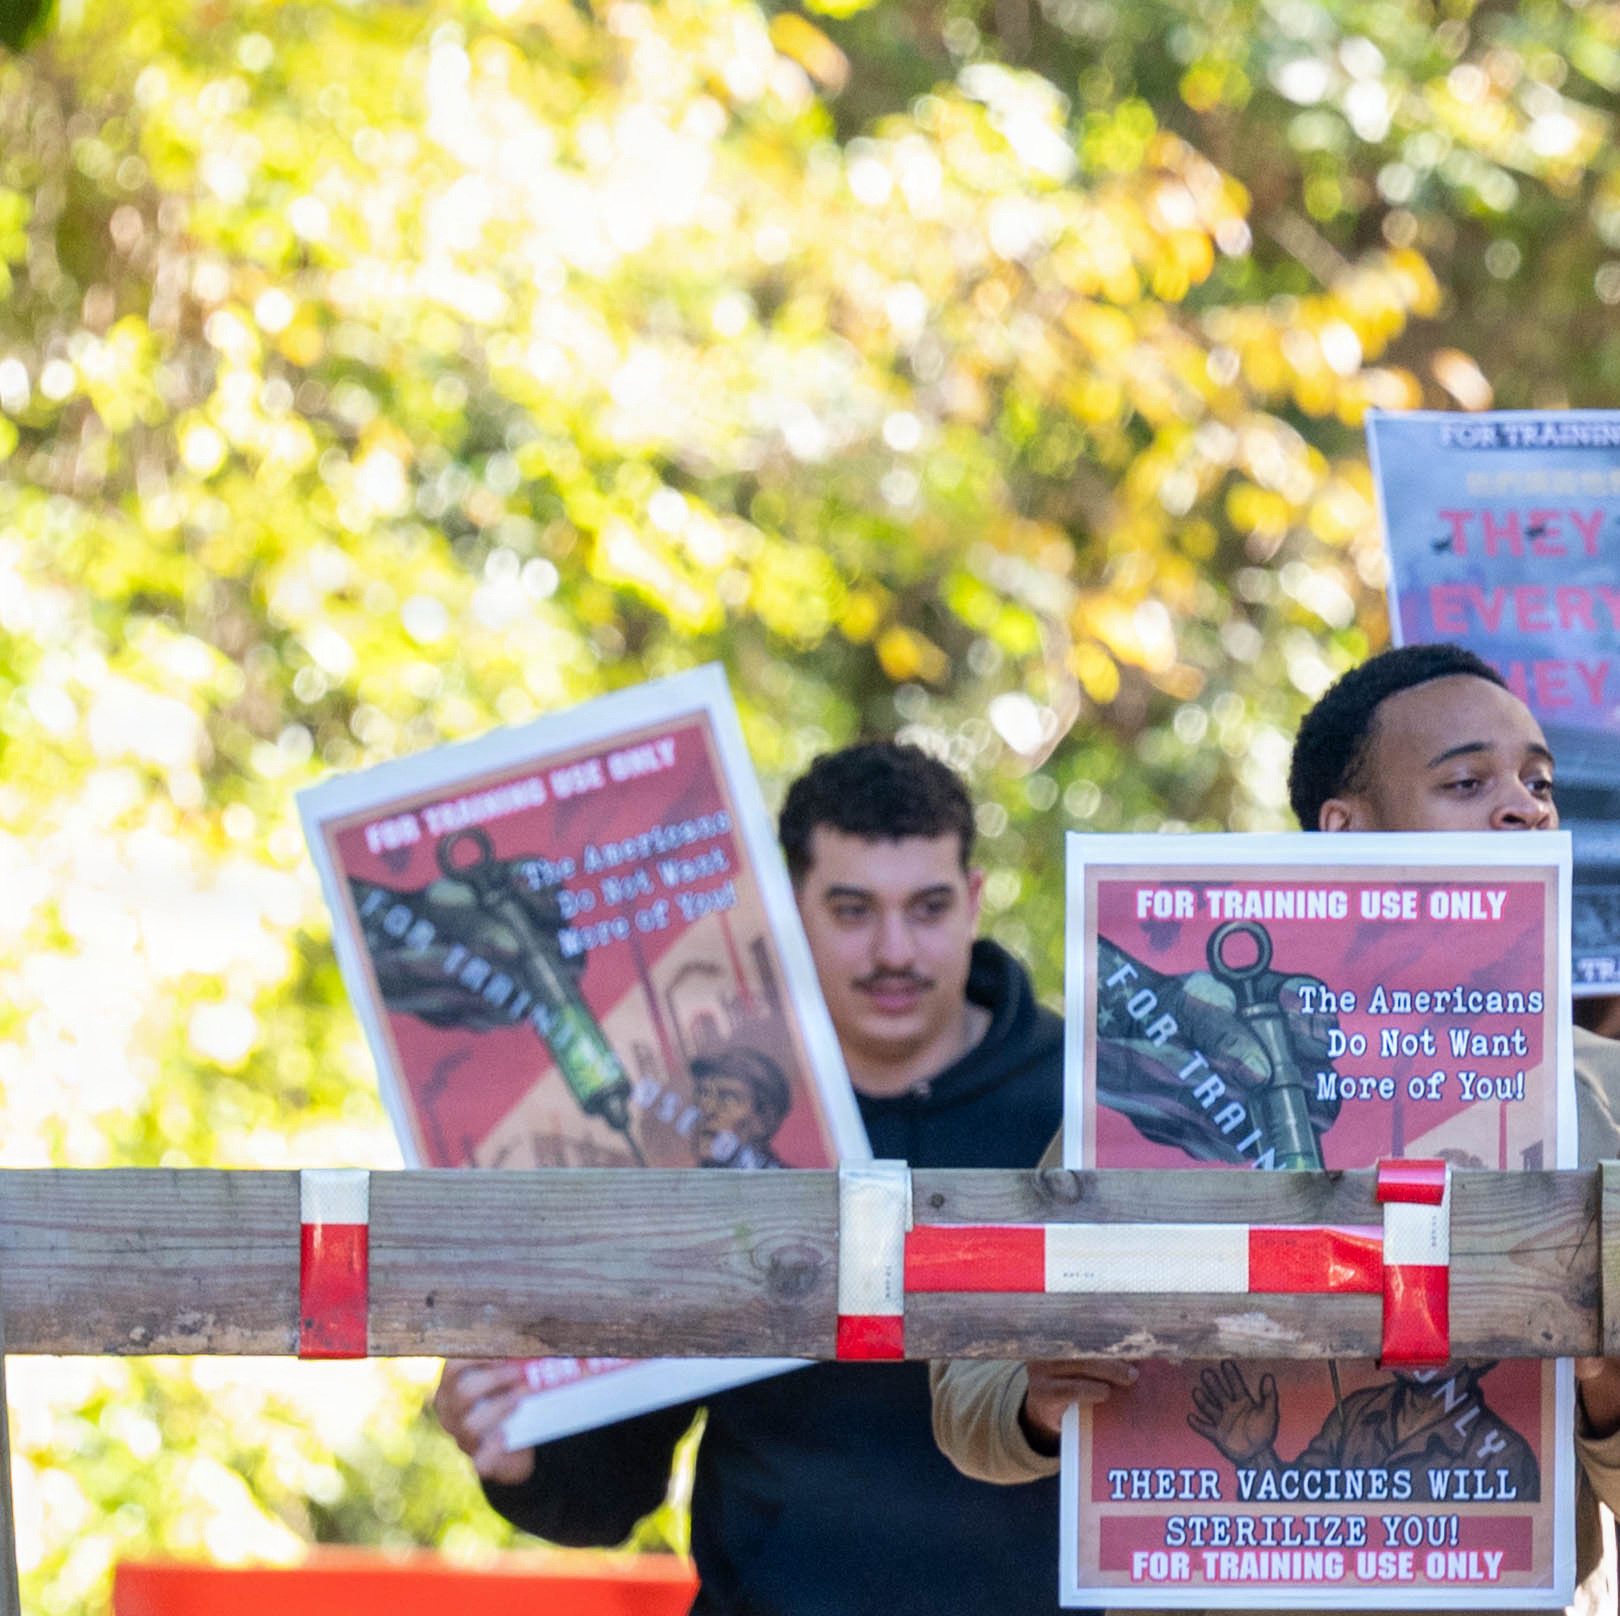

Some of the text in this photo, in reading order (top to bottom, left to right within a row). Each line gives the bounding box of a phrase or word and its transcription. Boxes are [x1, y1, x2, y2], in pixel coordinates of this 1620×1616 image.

[1440, 422, 1501, 448] FOR
[1439, 509, 1605, 557] THEY
[365, 737, 676, 855] FOR TRAINING USE ONLY
[522, 811, 732, 892] The Americans
[558, 848, 730, 920] Do Not Want
[1136, 889, 1507, 920] FOR TRAINING USE ONLY
[558, 916, 630, 957] More
[635, 898, 670, 933] of
[1106, 962, 1179, 1049] FOR
[1299, 985, 1543, 1015] The Americans
[1328, 1030, 1528, 1057] Do Not Want
[1317, 1071, 1526, 1101] More of You!
[1108, 1469, 1517, 1501] THEIR VACCINES WILL
[1165, 1515, 1460, 1547] STERILIZE YOU!
[1132, 1551, 1503, 1581] FOR TRAINING USE ONLY
